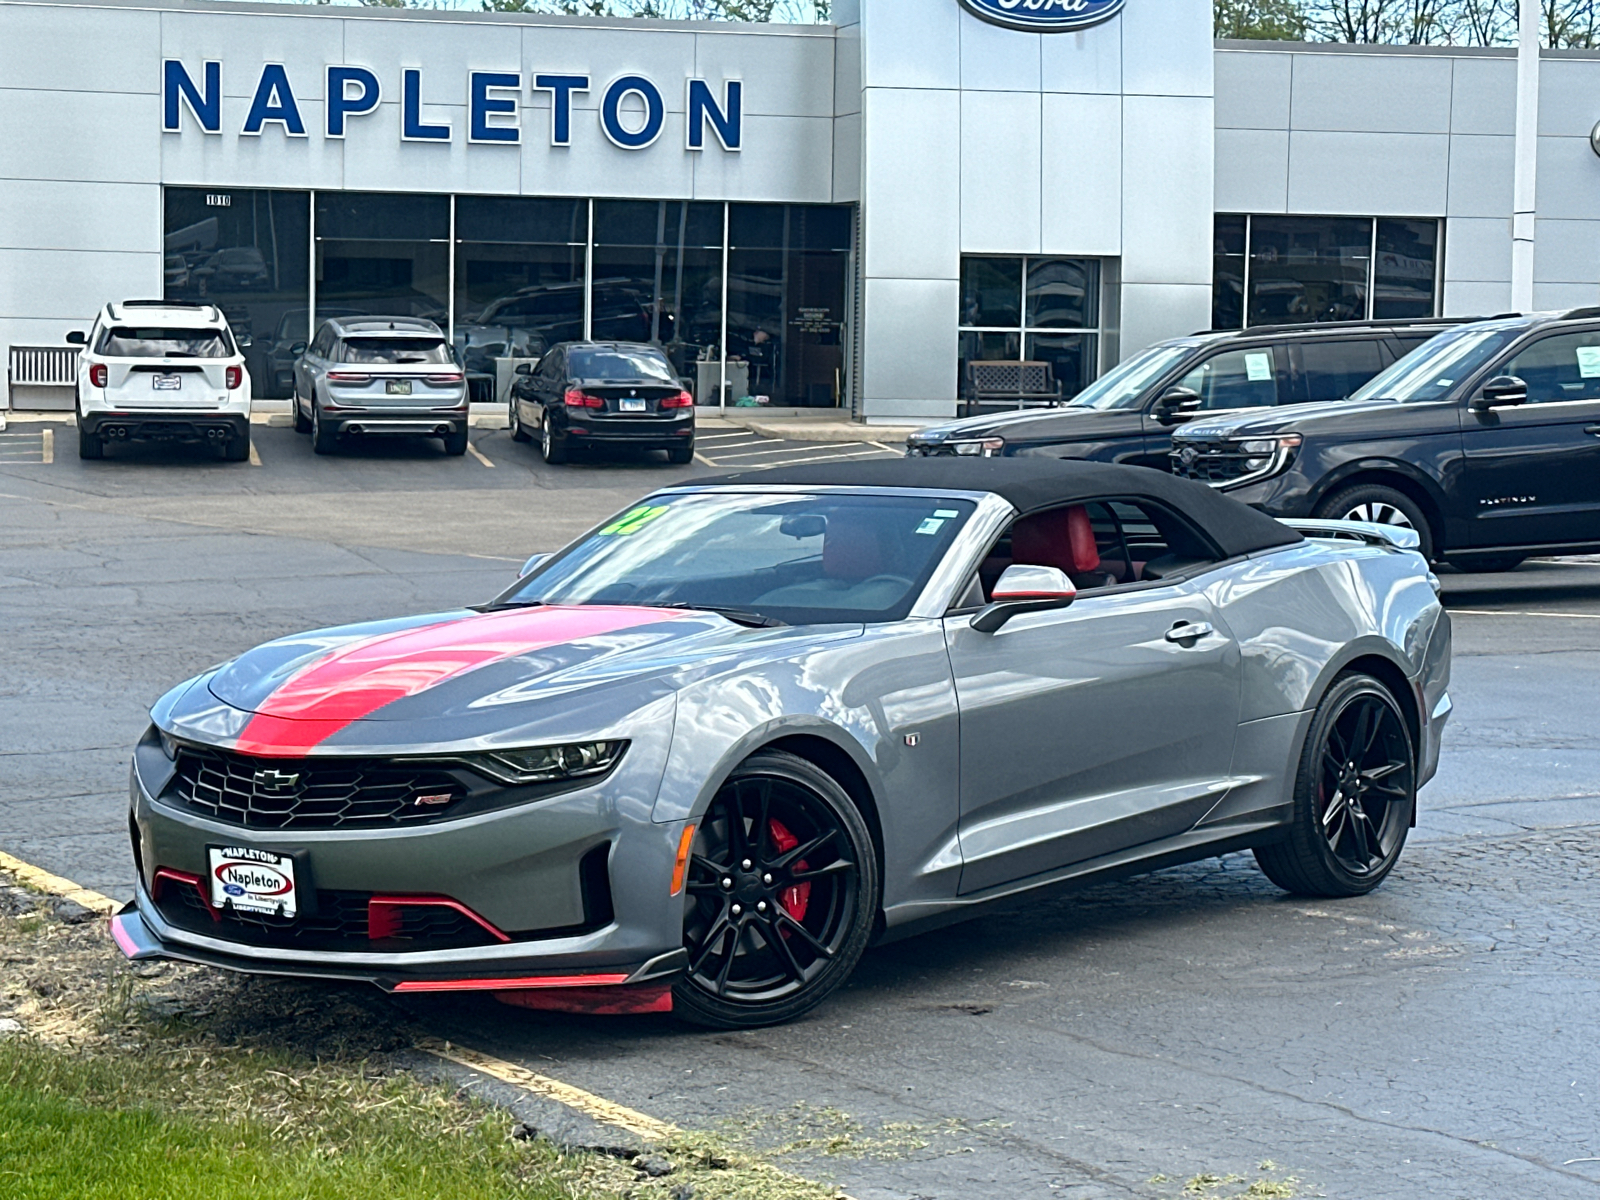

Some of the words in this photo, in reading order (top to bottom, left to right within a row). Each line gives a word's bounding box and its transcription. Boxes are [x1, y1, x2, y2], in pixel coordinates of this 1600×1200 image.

[998, 0, 1089, 12] ord
[162, 58, 742, 152] NAPLETON
[206, 194, 231, 207] 1010
[414, 793, 452, 806] RS
[226, 847, 276, 863] NAPLETON
[228, 867, 280, 890] Napleton
